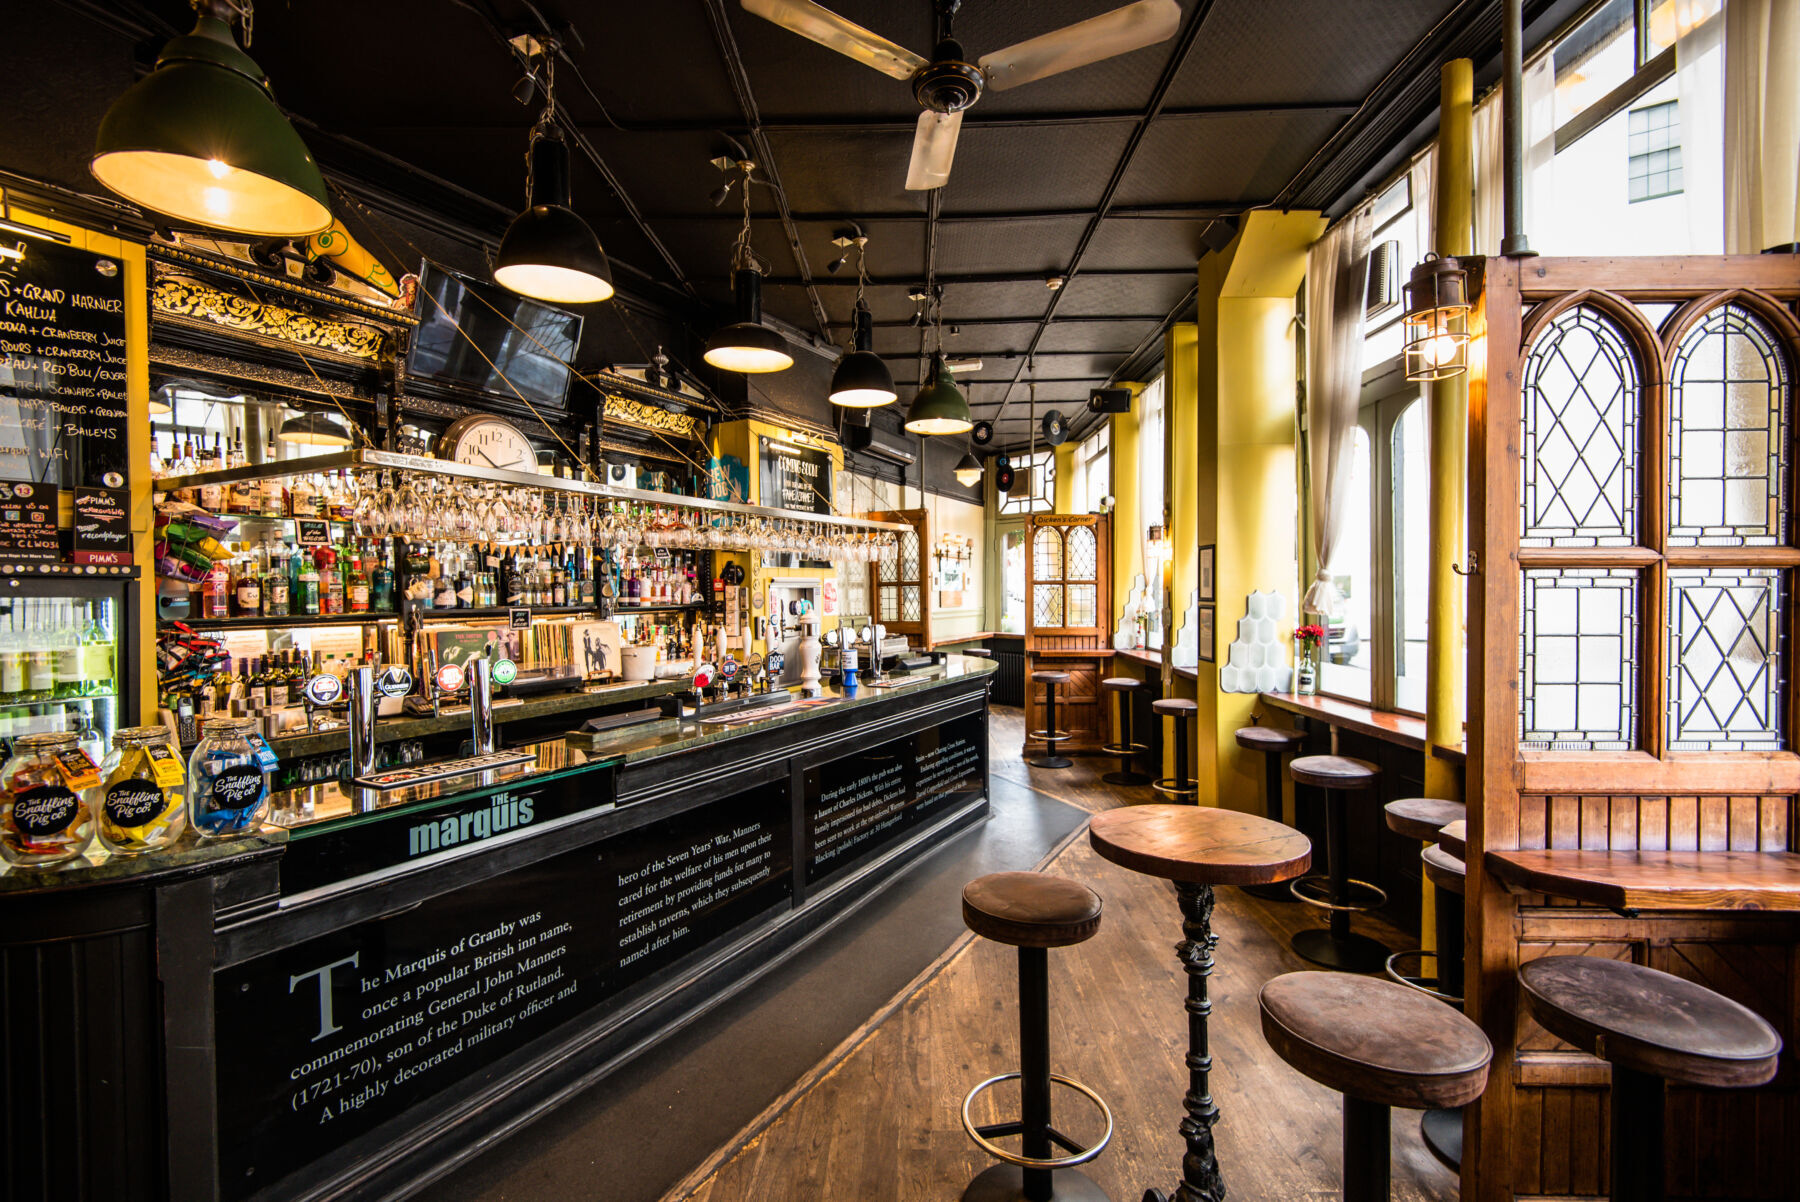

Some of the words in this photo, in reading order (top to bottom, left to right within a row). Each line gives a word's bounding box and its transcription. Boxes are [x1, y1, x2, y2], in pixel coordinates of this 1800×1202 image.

[23, 283, 65, 304] GRAND
[72, 294, 123, 313] MARNIER
[6, 300, 56, 322] KAHLUA
[42, 327, 97, 343] CRANBERRY
[0, 339, 31, 354] SOURS
[45, 346, 101, 362] CRANBERRY
[43, 361, 66, 375] RED
[67, 363, 92, 378] BULL
[64, 423, 117, 439] BAILEYS
[480, 434, 488, 445] 11
[492, 431, 502, 442] 12
[469, 444, 480, 456] 10
[778, 455, 801, 473] COMING
[89, 553, 118, 563] PIMM'S
[770, 662, 780, 670] BAR
[215, 774, 261, 792] Snaffling
[14, 795, 75, 818] Snaffling
[107, 791, 161, 809] Snaffling
[223, 789, 243, 802] Pig
[491, 792, 508, 806] THE
[821, 791, 838, 802] During
[114, 803, 134, 818] Pig
[818, 806, 833, 818] haunt
[839, 796, 856, 809] Charles
[24, 813, 50, 829] Pig
[409, 795, 534, 856] marquis
[815, 821, 830, 835] family
[831, 810, 856, 828] imprisoned
[814, 837, 826, 849] been
[827, 833, 837, 843] sent
[843, 824, 855, 835] work
[618, 872, 638, 887] hero
[641, 863, 650, 877] of
[652, 860, 665, 873] the
[667, 851, 689, 866] Seven
[715, 834, 731, 846] War,
[732, 822, 760, 840] Manners
[815, 848, 836, 864] Blacking
[854, 832, 869, 843] Factory
[618, 887, 642, 907] cared
[645, 882, 657, 896] for
[660, 875, 672, 888] the
[674, 863, 702, 882] welfare
[704, 857, 711, 869] of
[713, 853, 723, 865] his
[724, 849, 739, 860] men
[740, 841, 757, 854] upon
[758, 832, 772, 845] their
[619, 899, 663, 927] retirement
[665, 894, 675, 905] by
[677, 877, 713, 902] providing
[714, 870, 733, 883] funds
[734, 862, 744, 873] for
[745, 855, 762, 868] many
[764, 851, 771, 859] to
[619, 920, 657, 947] establish
[659, 907, 690, 927] taverns,
[691, 893, 714, 911] which
[715, 886, 729, 899] they
[731, 866, 771, 891] subsequently
[385, 948, 446, 984] Marquis
[450, 938, 466, 956] of
[468, 922, 516, 948] Granby
[519, 912, 542, 928] was
[620, 942, 649, 968] named
[651, 934, 671, 951] after
[673, 926, 690, 940] him.
[362, 996, 398, 1019] once
[402, 990, 411, 1002] a
[416, 966, 470, 1000] popular
[474, 944, 514, 970] British
[518, 938, 536, 952] inn
[540, 922, 572, 942] name,
[290, 1011, 424, 1080] commemorating
[428, 980, 480, 1015] General
[484, 970, 514, 994] John
[516, 945, 566, 975] Manners
[292, 1056, 382, 1112] (1721-70),
[386, 1042, 412, 1062] son
[418, 1026, 433, 1046] of
[436, 1020, 458, 1038] the
[462, 1001, 496, 1026] Duke
[500, 988, 513, 1006] of
[516, 966, 564, 999] Rutland.
[320, 1106, 334, 1124] A
[340, 1080, 390, 1114] highly
[394, 1038, 462, 1084] decorated
[467, 1014, 516, 1048] military
[519, 994, 554, 1020] officer
[557, 980, 577, 1000] and
